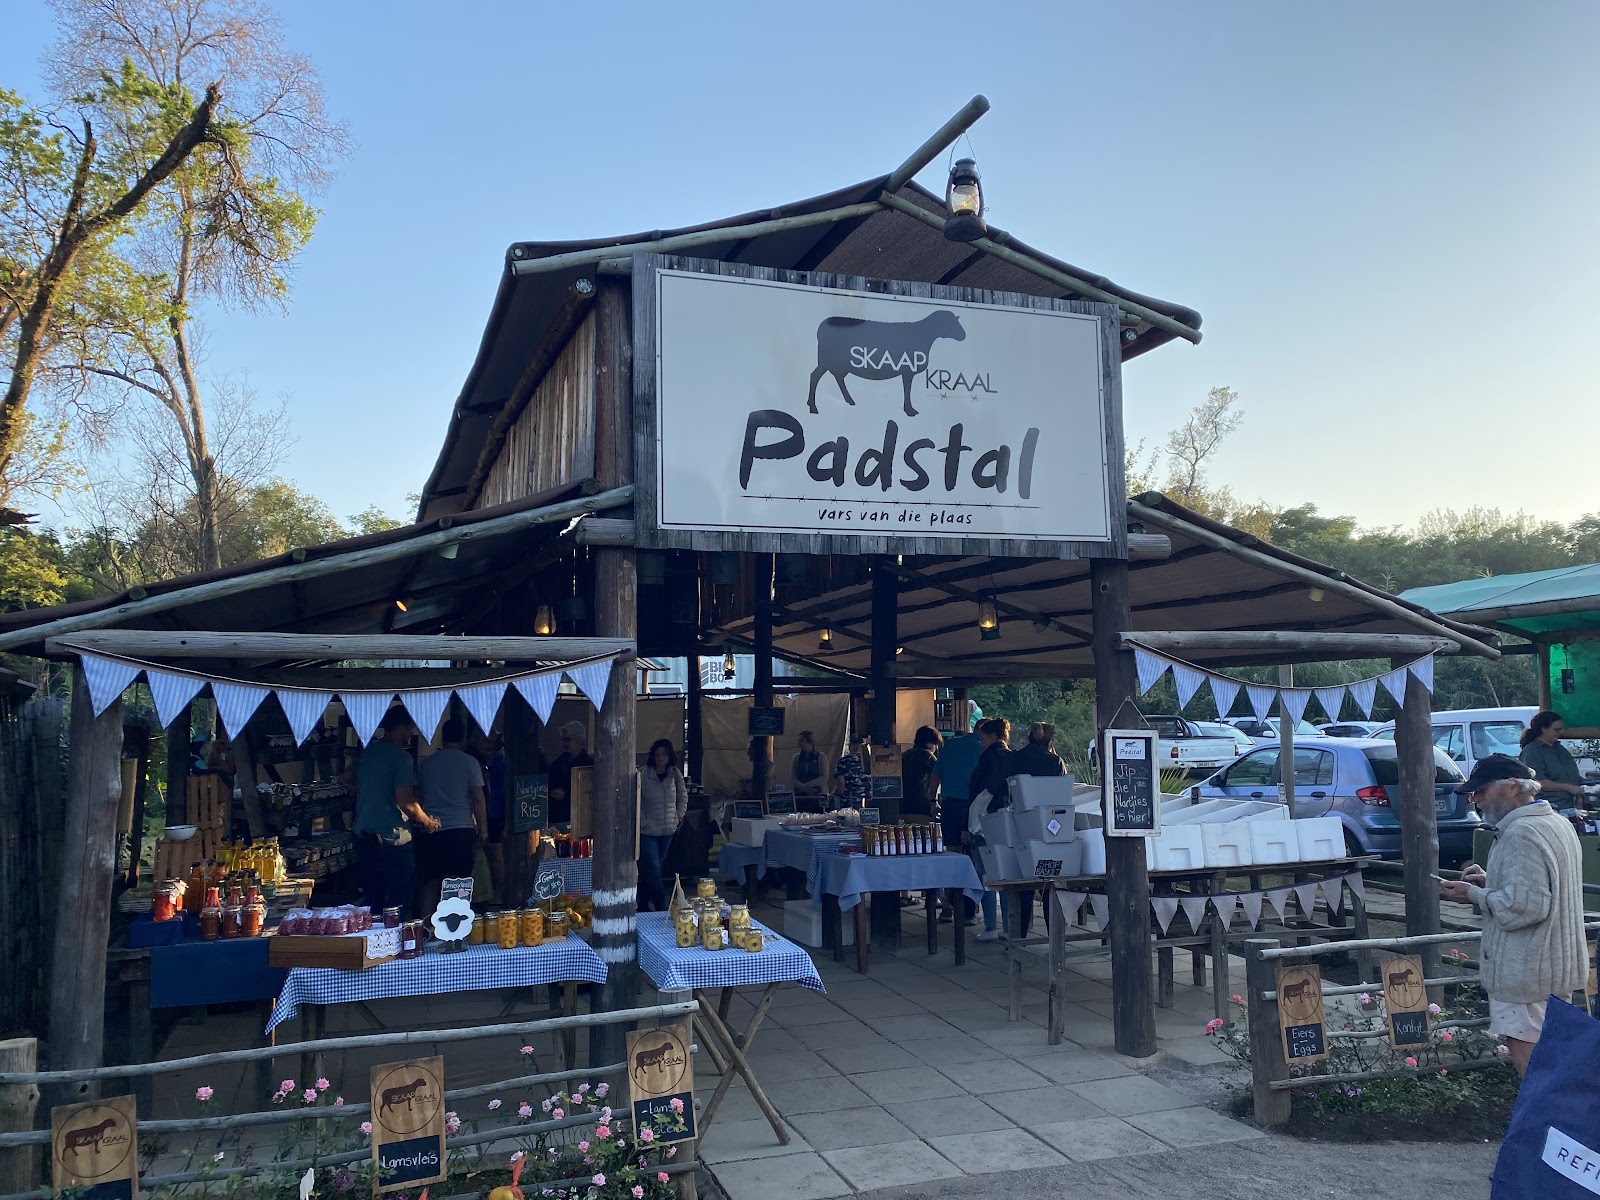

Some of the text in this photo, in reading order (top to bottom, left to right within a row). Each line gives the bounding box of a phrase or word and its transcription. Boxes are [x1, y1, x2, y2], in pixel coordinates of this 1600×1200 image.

[850, 346, 927, 372] SKAAP
[926, 369, 998, 394] KRAAL
[739, 409, 1040, 500] Padstal
[818, 509, 973, 527] vars van die plaas
[1116, 764, 1136, 786] Jip
[1114, 780, 1129, 793] die
[521, 801, 540, 818] R15
[1116, 809, 1126, 822] is
[1036, 867, 1061, 876] BASKET
[1039, 861, 1061, 869] SHOP
[1292, 1028, 1315, 1039] Eiers
[1293, 1043, 1317, 1056] Eggs
[382, 1152, 438, 1170] Lamsvleis
